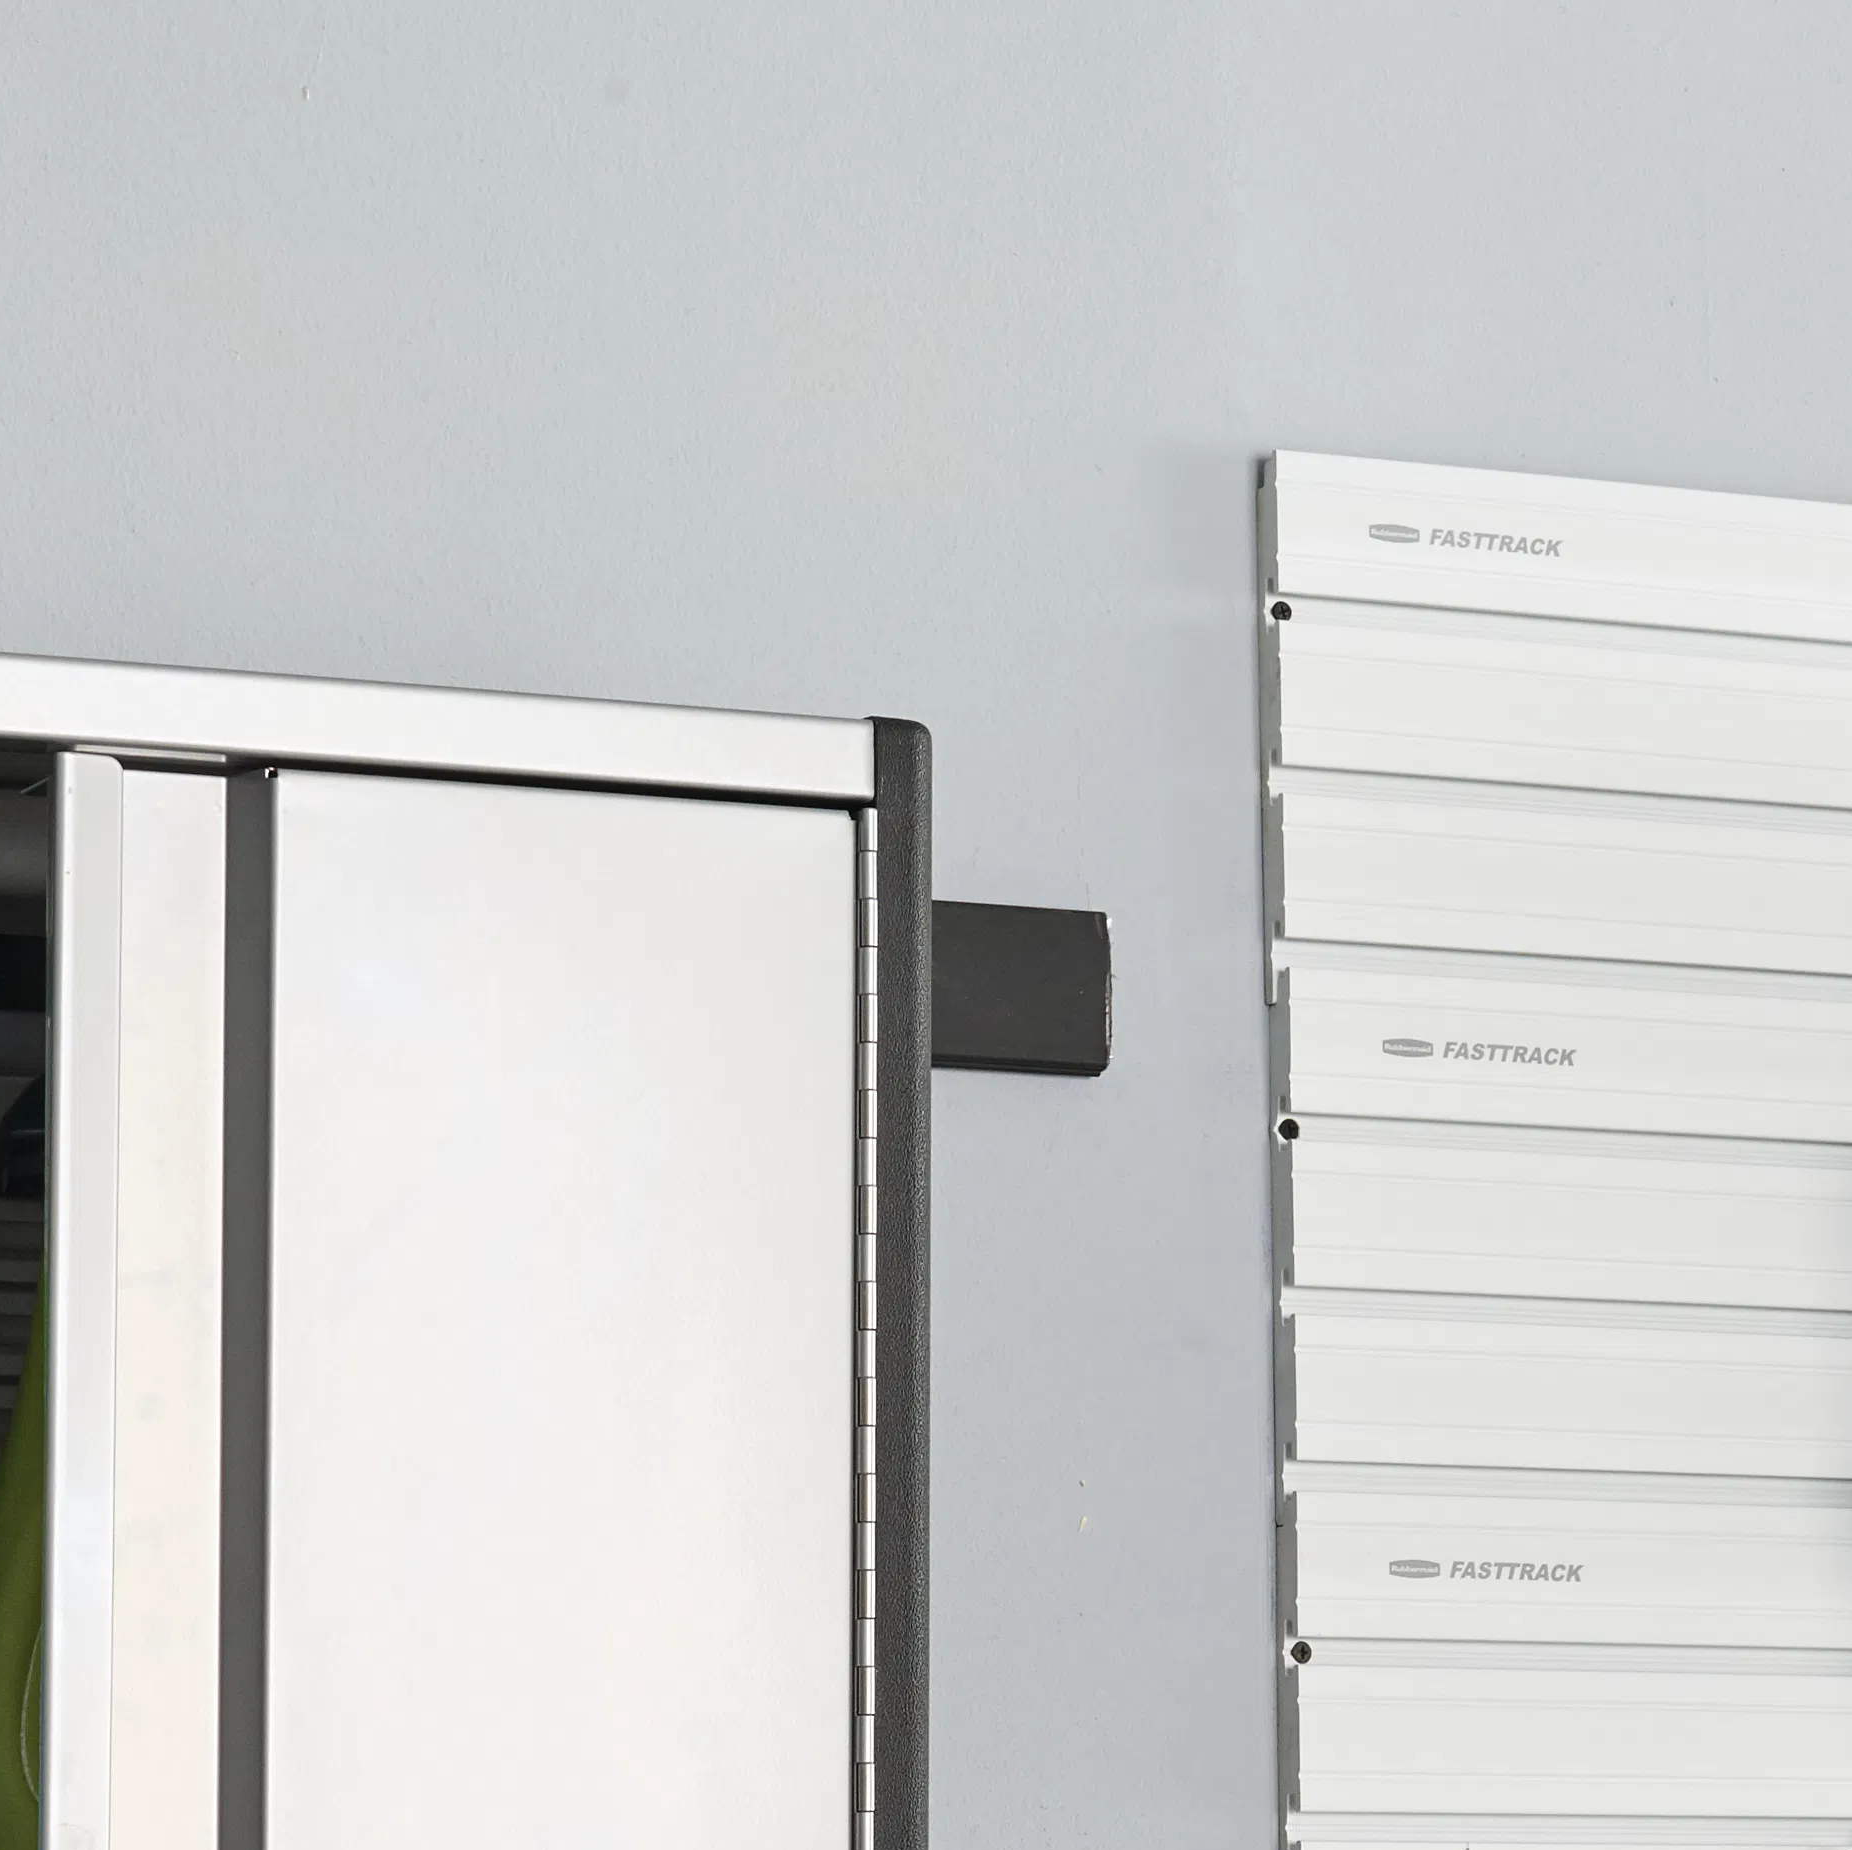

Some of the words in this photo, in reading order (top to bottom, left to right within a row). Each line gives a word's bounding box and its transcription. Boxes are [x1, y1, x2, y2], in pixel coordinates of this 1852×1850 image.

[1429, 528, 1563, 557] FASTTRACK
[1443, 1041, 1577, 1067] FASTTRACK
[1450, 1561, 1584, 1582] FASTTRACK
